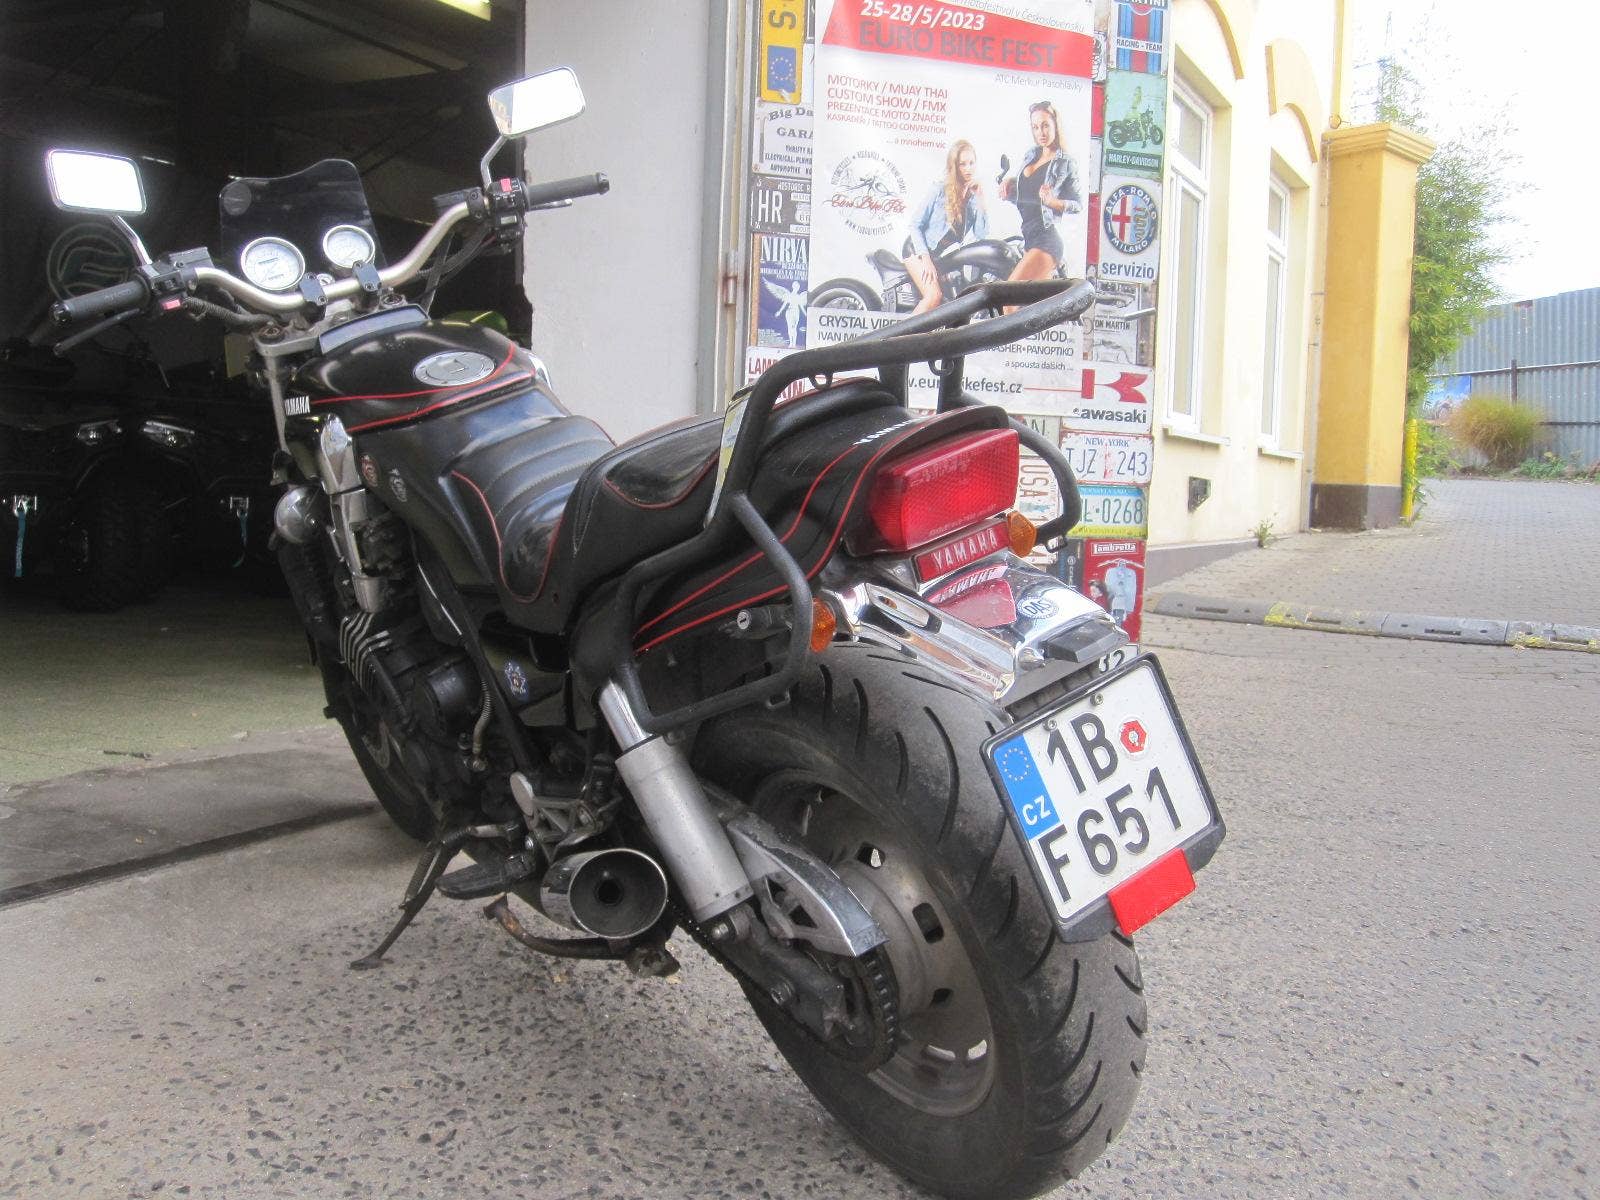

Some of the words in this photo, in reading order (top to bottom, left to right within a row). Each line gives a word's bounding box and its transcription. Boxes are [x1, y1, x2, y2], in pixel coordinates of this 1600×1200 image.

[860, 0, 986, 31] 25-28/5/2023
[859, 20, 934, 52] EURO
[940, 31, 996, 63] BIKE
[1002, 38, 1059, 67] FEST
[1117, 38, 1140, 49] RACING
[1145, 42, 1163, 52] TEAM
[827, 74, 880, 91] MOTORKY
[889, 83, 922, 95] MUAY
[924, 87, 948, 99] THAI
[827, 87, 874, 104] CUSTOM
[876, 95, 912, 109] SHOW
[922, 100, 947, 112] FMX
[768, 109, 793, 121] Big
[827, 101, 880, 117] PREZENTACE
[881, 109, 911, 120] MOTO
[872, 119, 898, 130] TATTOO
[899, 123, 947, 134] CONVENTION
[760, 236, 808, 264] NIRVA
[1111, 237, 1149, 253] MILANO
[1102, 261, 1155, 279] servizio
[818, 314, 869, 330] CRYSTAL
[818, 330, 842, 342] IVAN
[1011, 361, 1040, 370] spousta
[1080, 407, 1148, 424] awasaki
[1084, 437, 1104, 446] NEW
[1108, 438, 1130, 448] YORK
[1116, 450, 1148, 477] 243
[932, 528, 998, 570] YAMAHA
[1046, 712, 1119, 795] 1B
[1021, 794, 1051, 826] CZ
[1036, 766, 1182, 903] F651
